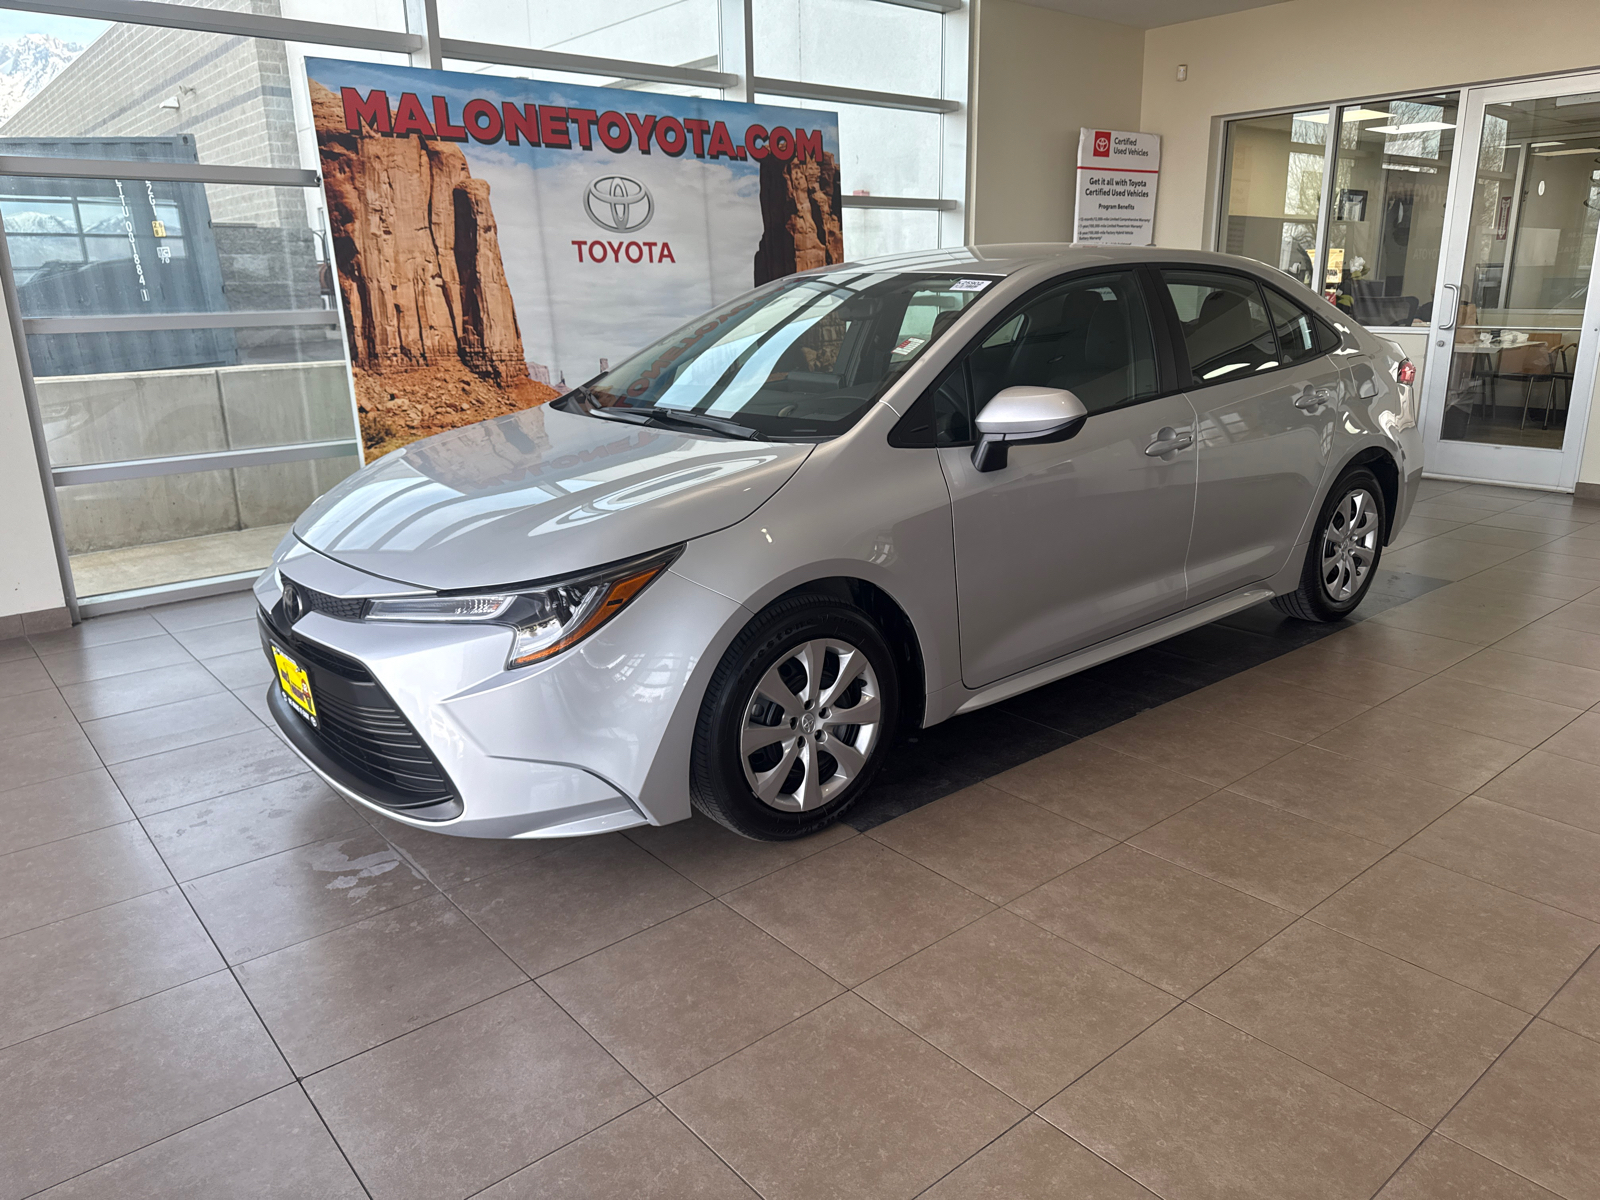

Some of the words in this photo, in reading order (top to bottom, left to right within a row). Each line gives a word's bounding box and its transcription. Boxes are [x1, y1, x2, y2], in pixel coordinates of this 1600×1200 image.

[340, 86, 823, 163] MALONETOYOTA.COM
[1114, 137, 1137, 146] Certified
[1113, 147, 1127, 155] Used
[1128, 148, 1149, 157] Vehicles
[1089, 177, 1100, 186] Get
[1101, 177, 1105, 186] it
[1106, 178, 1114, 186] all
[1115, 178, 1128, 187] with
[1129, 179, 1147, 188] Toyota
[1085, 188, 1111, 197] Certified
[1111, 188, 1126, 197] Used
[1127, 189, 1149, 198] Vehicles
[1098, 203, 1117, 211] Program
[571, 239, 676, 264] TOYOTA
